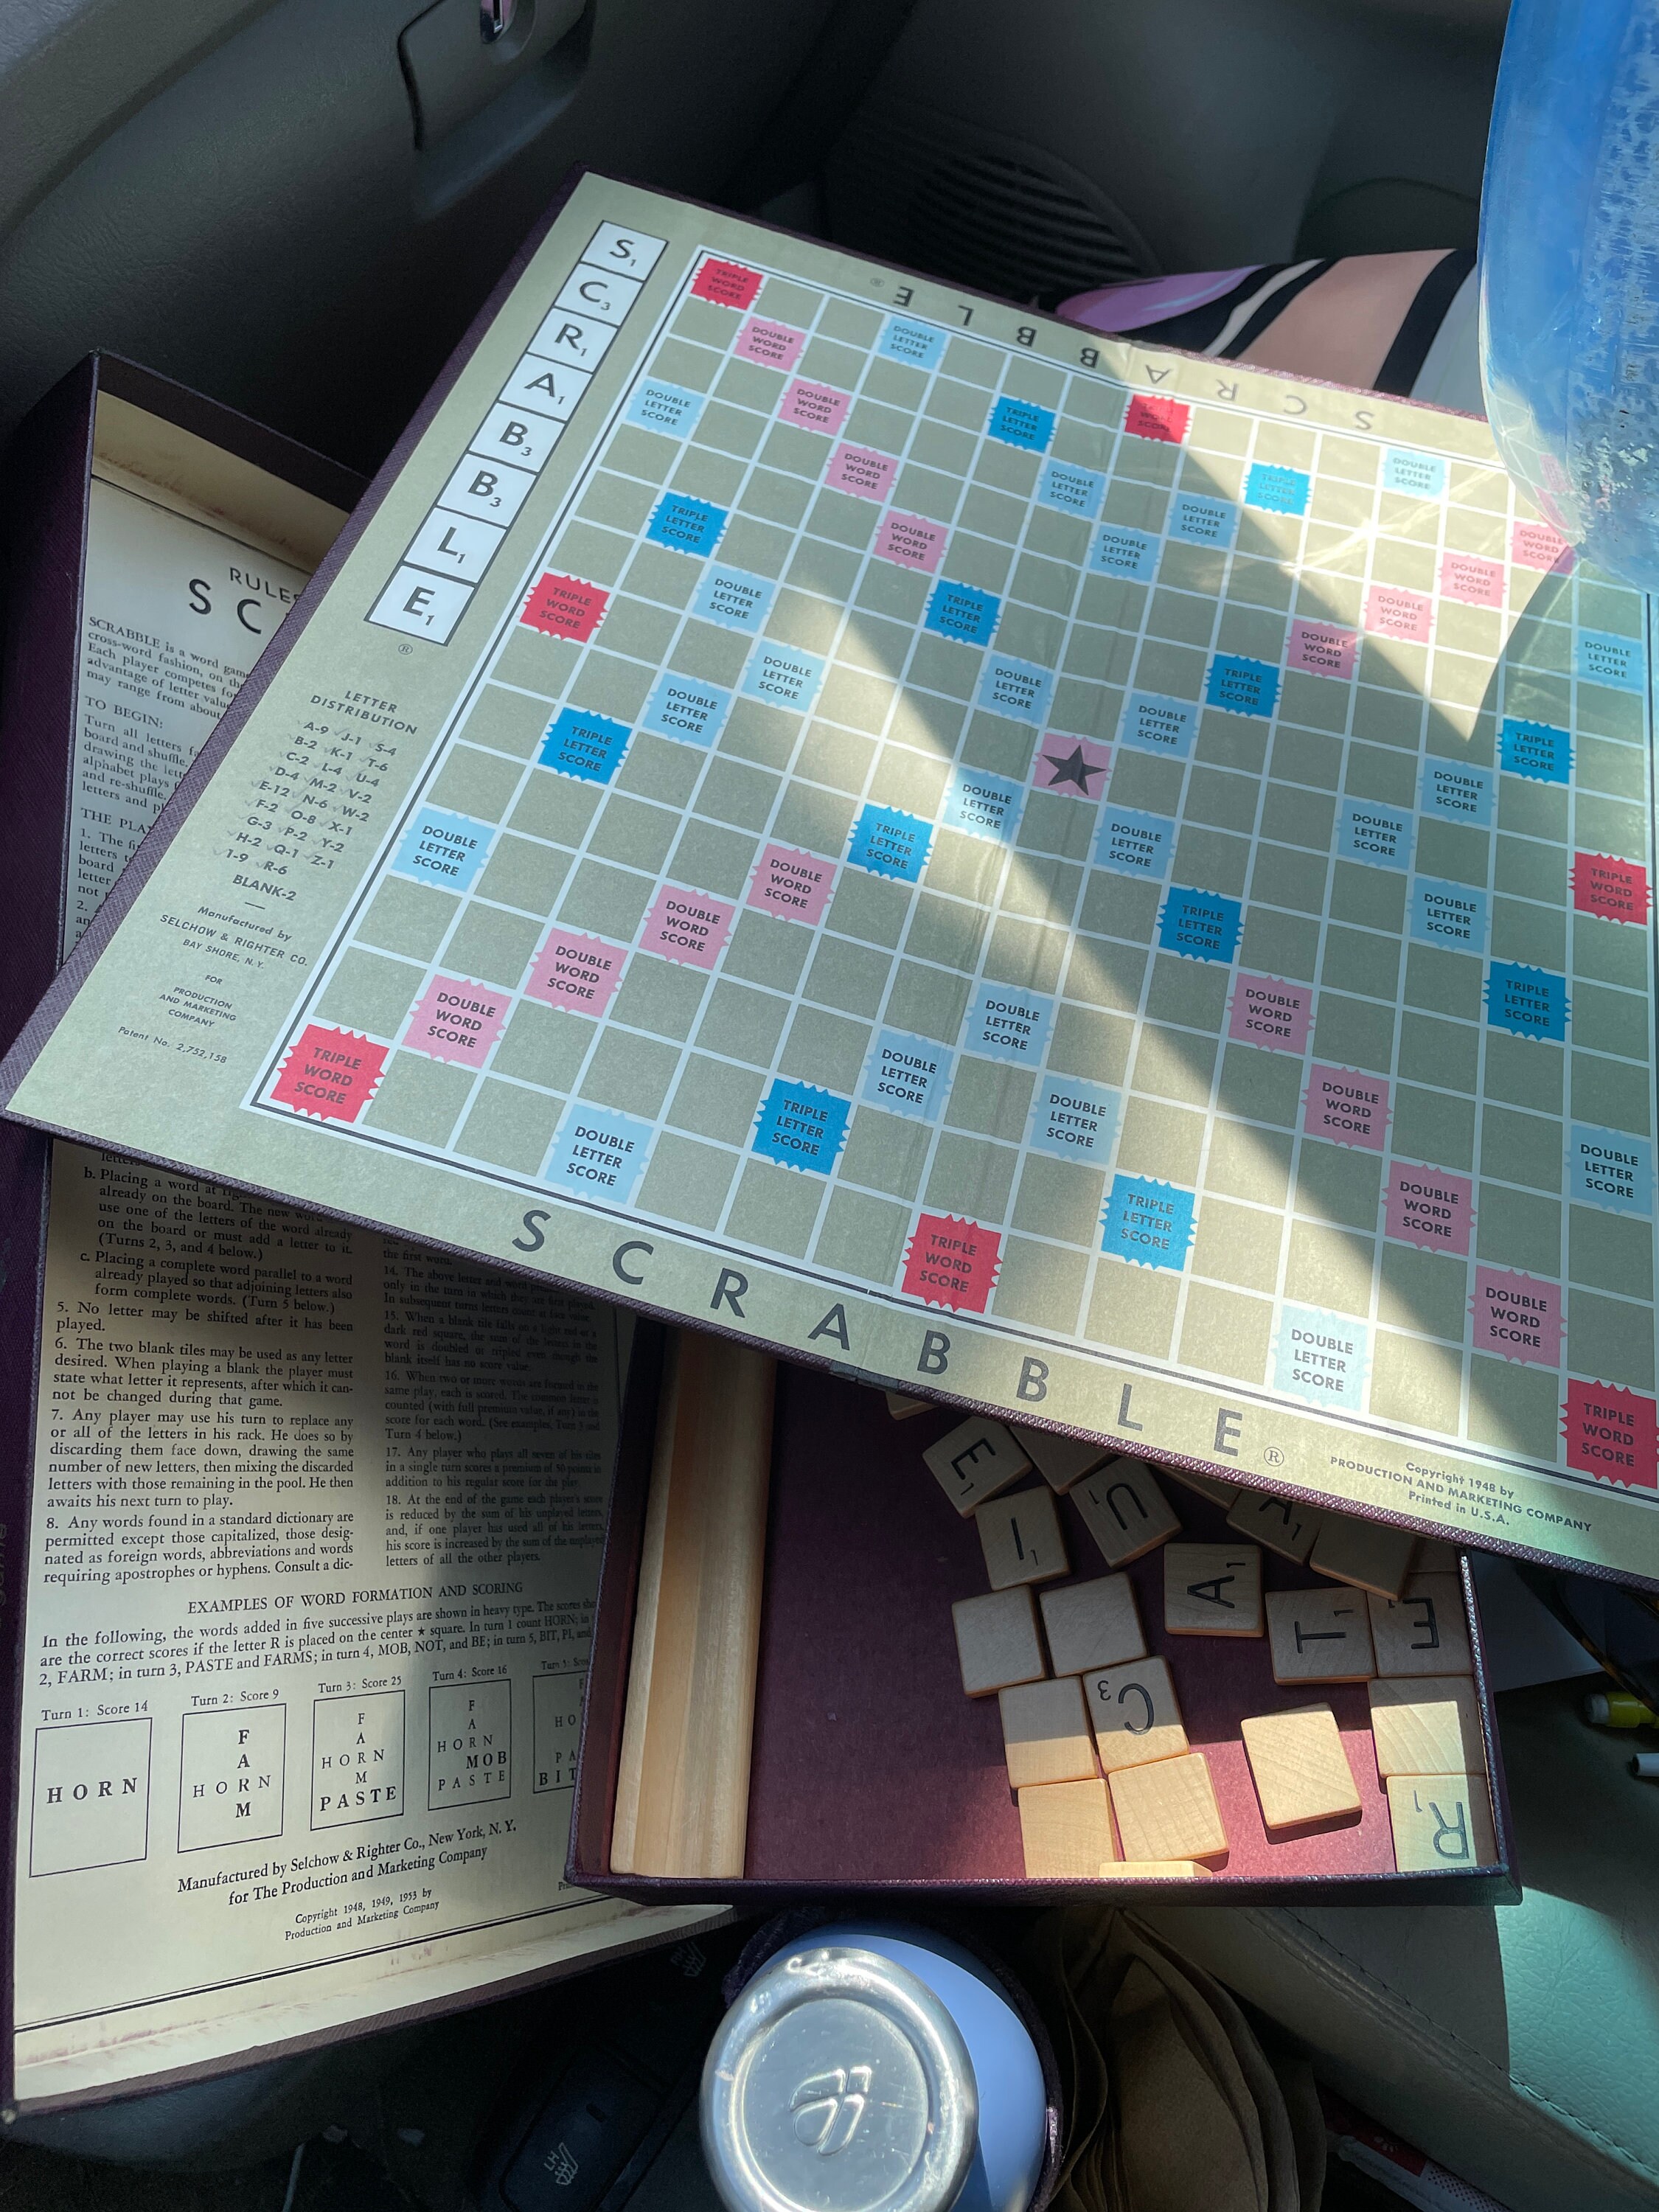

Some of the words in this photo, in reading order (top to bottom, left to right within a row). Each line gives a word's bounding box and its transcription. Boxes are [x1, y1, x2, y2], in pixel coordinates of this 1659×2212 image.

[644, 399, 682, 416] LETTER
[645, 389, 690, 408] DOUBLE
[640, 408, 678, 425] SCORE
[665, 515, 704, 532] LETTER
[672, 504, 709, 521] TRIPLE
[661, 526, 700, 543] SCORE
[890, 521, 936, 541] DOUBLE
[891, 532, 928, 549] WORD
[887, 543, 925, 561] SCORE
[546, 598, 585, 617] WORD
[552, 586, 592, 606] TRIPLE
[538, 609, 581, 629] SCORE
[87, 616, 160, 649] SCRABBLE
[164, 641, 174, 653] is
[178, 649, 186, 663] a
[189, 652, 218, 669] word
[1301, 630, 1347, 648] DOUBLE
[1304, 642, 1341, 657] WORD
[1301, 653, 1340, 669] SCORE
[84, 695, 106, 710] TO
[113, 703, 163, 728] BEGIN:
[344, 689, 397, 713] LETTER
[309, 694, 417, 734] DISTRIBUTION
[303, 721, 329, 734] A-9
[341, 732, 361, 745] J-1
[375, 742, 396, 756] S-4
[1514, 731, 1554, 747] TRIPLE
[293, 735, 317, 749] B-2
[330, 746, 352, 760] K-1
[368, 757, 388, 771] T-6
[1514, 743, 1554, 759] LETTER
[1514, 755, 1552, 771] SCORE
[258, 780, 290, 797] E-12
[302, 794, 327, 808] N-6
[342, 805, 369, 822] W-2
[246, 815, 272, 830] G-3
[283, 826, 307, 841] P-2
[322, 837, 344, 852] Y-2
[235, 832, 262, 847] H-2
[273, 844, 299, 858] Q-1
[310, 855, 334, 869] Z-1
[232, 873, 296, 901] BLANK-2
[196, 905, 274, 935] Manufactured
[276, 929, 292, 942] by
[159, 914, 217, 937] SELCHOW
[219, 932, 228, 942] &
[233, 936, 285, 959] RIGHTER
[289, 953, 307, 967] CO.
[181, 938, 202, 950] BAY
[204, 944, 240, 962] SHORE,
[204, 973, 223, 984] FOR
[158, 993, 180, 1004] AND
[182, 1000, 236, 1021] MARKETING
[173, 986, 232, 1009] PRODUCTION
[167, 1008, 215, 1027] COMPANY
[117, 1025, 150, 1040] Patent
[152, 1035, 172, 1048] No.
[175, 1042, 228, 1064] 2,752,158
[313, 1046, 362, 1070] TRIPLE
[304, 1062, 352, 1087] WORD
[293, 1080, 347, 1105] SCORE
[574, 1125, 635, 1153] DOUBLE
[571, 1144, 622, 1169] LETTER
[1580, 1143, 1638, 1166] DOUBLE
[566, 1161, 616, 1186] SCORE
[1584, 1161, 1633, 1182] LETTER
[1585, 1177, 1633, 1198] SCORE
[930, 1233, 977, 1256] TRIPLE
[925, 1251, 972, 1273] WORD
[918, 1269, 968, 1293] SCORE
[55, 1316, 105, 1334] played.
[56, 1301, 69, 1312] 5.
[76, 1300, 100, 1315] No
[107, 1302, 144, 1317] letter
[150, 1310, 178, 1323] may
[185, 1307, 200, 1321] be
[206, 1310, 248, 1324] shifted
[255, 1313, 282, 1326] after
[289, 1315, 298, 1327] it
[305, 1316, 322, 1329] has
[328, 1318, 352, 1331] been
[1582, 1402, 1634, 1427] TRIPLE
[1582, 1421, 1633, 1446] WORD
[1581, 1441, 1635, 1467] SCORE
[1405, 1461, 1464, 1485] Copyright
[1468, 1477, 1496, 1493] 1948
[1499, 1485, 1514, 1499] by
[1329, 1455, 1413, 1486] PRODUCTION
[1416, 1478, 1444, 1493] AND
[1447, 1486, 1523, 1514] MARKETING
[1526, 1507, 1591, 1532] COMPANY
[1408, 1489, 1451, 1510] Printed
[1455, 1502, 1466, 1514] in
[1470, 1506, 1509, 1526] U.S.A.
[46, 1517, 58, 1528] 8.
[67, 1515, 98, 1532] Any
[102, 1514, 143, 1528] words
[147, 1513, 187, 1527] found
[191, 1512, 204, 1526] in
[208, 1517, 215, 1526] a
[218, 1511, 272, 1526] standard
[275, 1511, 334, 1526] dictionary
[336, 1513, 354, 1522] are
[187, 1596, 268, 1614] EXAMPLES
[274, 1595, 294, 1609] OF
[299, 1591, 346, 1607] WORD
[351, 1586, 432, 1603] FORMATION
[437, 1584, 467, 1598] AND
[469, 1581, 523, 1598] SCORING
[190, 1694, 218, 1706] Turn
[222, 1693, 233, 1703] 2:
[240, 1690, 269, 1702] Score
[272, 1688, 279, 1700] 9
[41, 1708, 72, 1721] Turn
[77, 1707, 88, 1718] 1:
[97, 1703, 130, 1716] Score
[134, 1699, 147, 1712] 14
[176, 1863, 268, 1893] Manufactured
[271, 1861, 287, 1879] by
[290, 1854, 339, 1872] Selchow
[342, 1849, 353, 1862] &
[355, 1842, 400, 1861] Righter
[403, 1837, 425, 1850] Co.,
[428, 1832, 453, 1846] New
[456, 1825, 485, 1840] York,
[228, 1890, 249, 1905] for
[251, 1885, 278, 1901] The
[281, 1871, 347, 1895] Production
[350, 1864, 373, 1882] and
[376, 1854, 435, 1877] Marketing
[438, 1847, 487, 1865] Company
[294, 1907, 338, 1924] Copyright
[343, 1901, 366, 1914] 1948,
[371, 1896, 393, 1908] 1949,
[399, 1890, 417, 1902] 1953
[421, 1887, 431, 1899] by
[285, 1922, 332, 1941] Production
[335, 1916, 352, 1930] and
[356, 1909, 399, 1925] Marketing
[402, 1901, 439, 1915] Company
